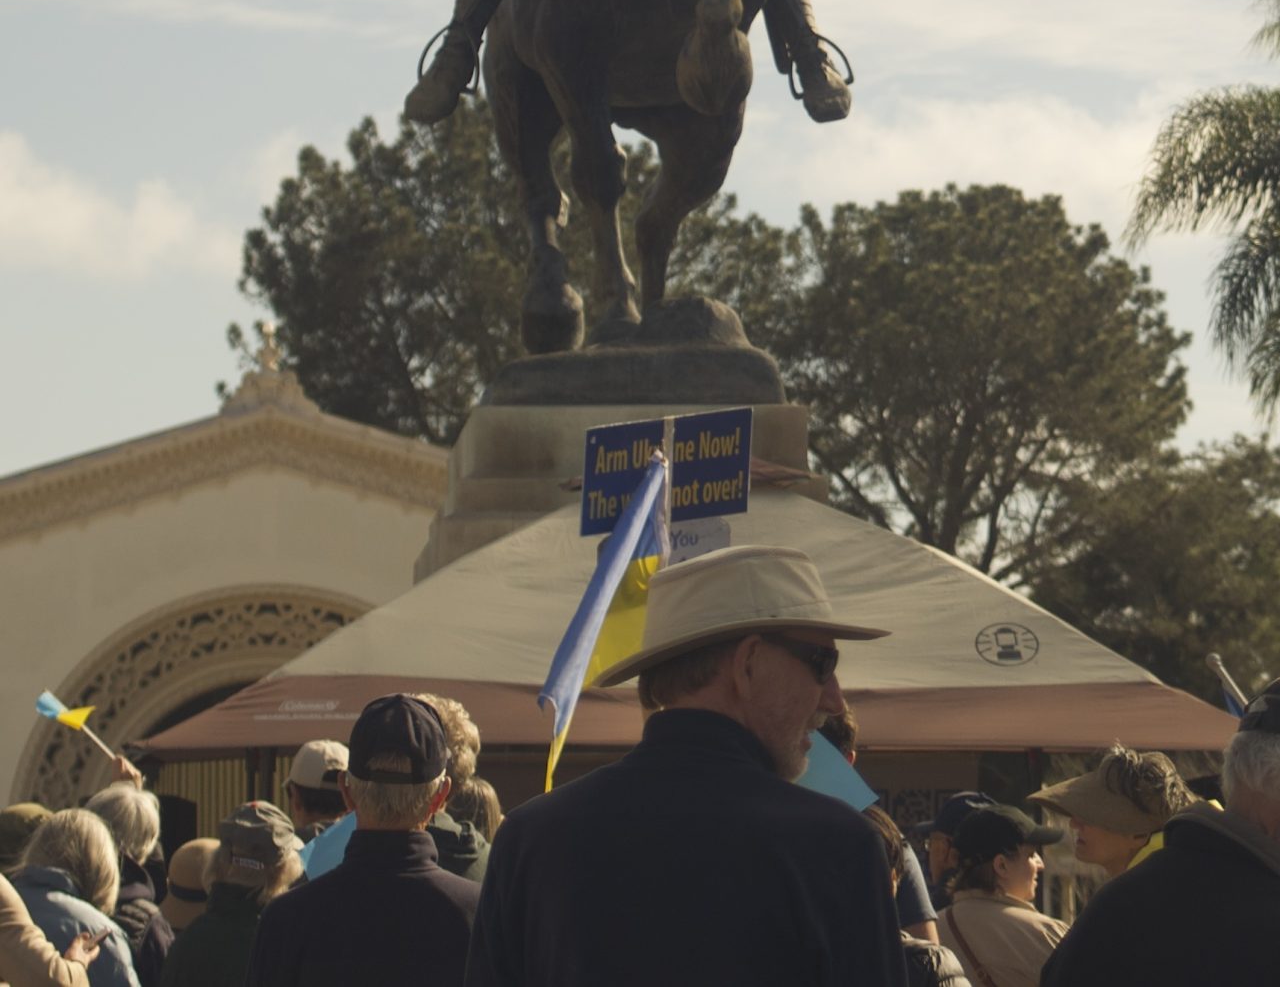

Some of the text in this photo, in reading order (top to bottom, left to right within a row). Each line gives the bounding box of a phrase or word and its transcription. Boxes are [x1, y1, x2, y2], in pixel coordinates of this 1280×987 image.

[595, 427, 741, 475] Arm Ukne Now!
[588, 490, 617, 520] The
[671, 479, 699, 508] not
[702, 470, 744, 504] over!
